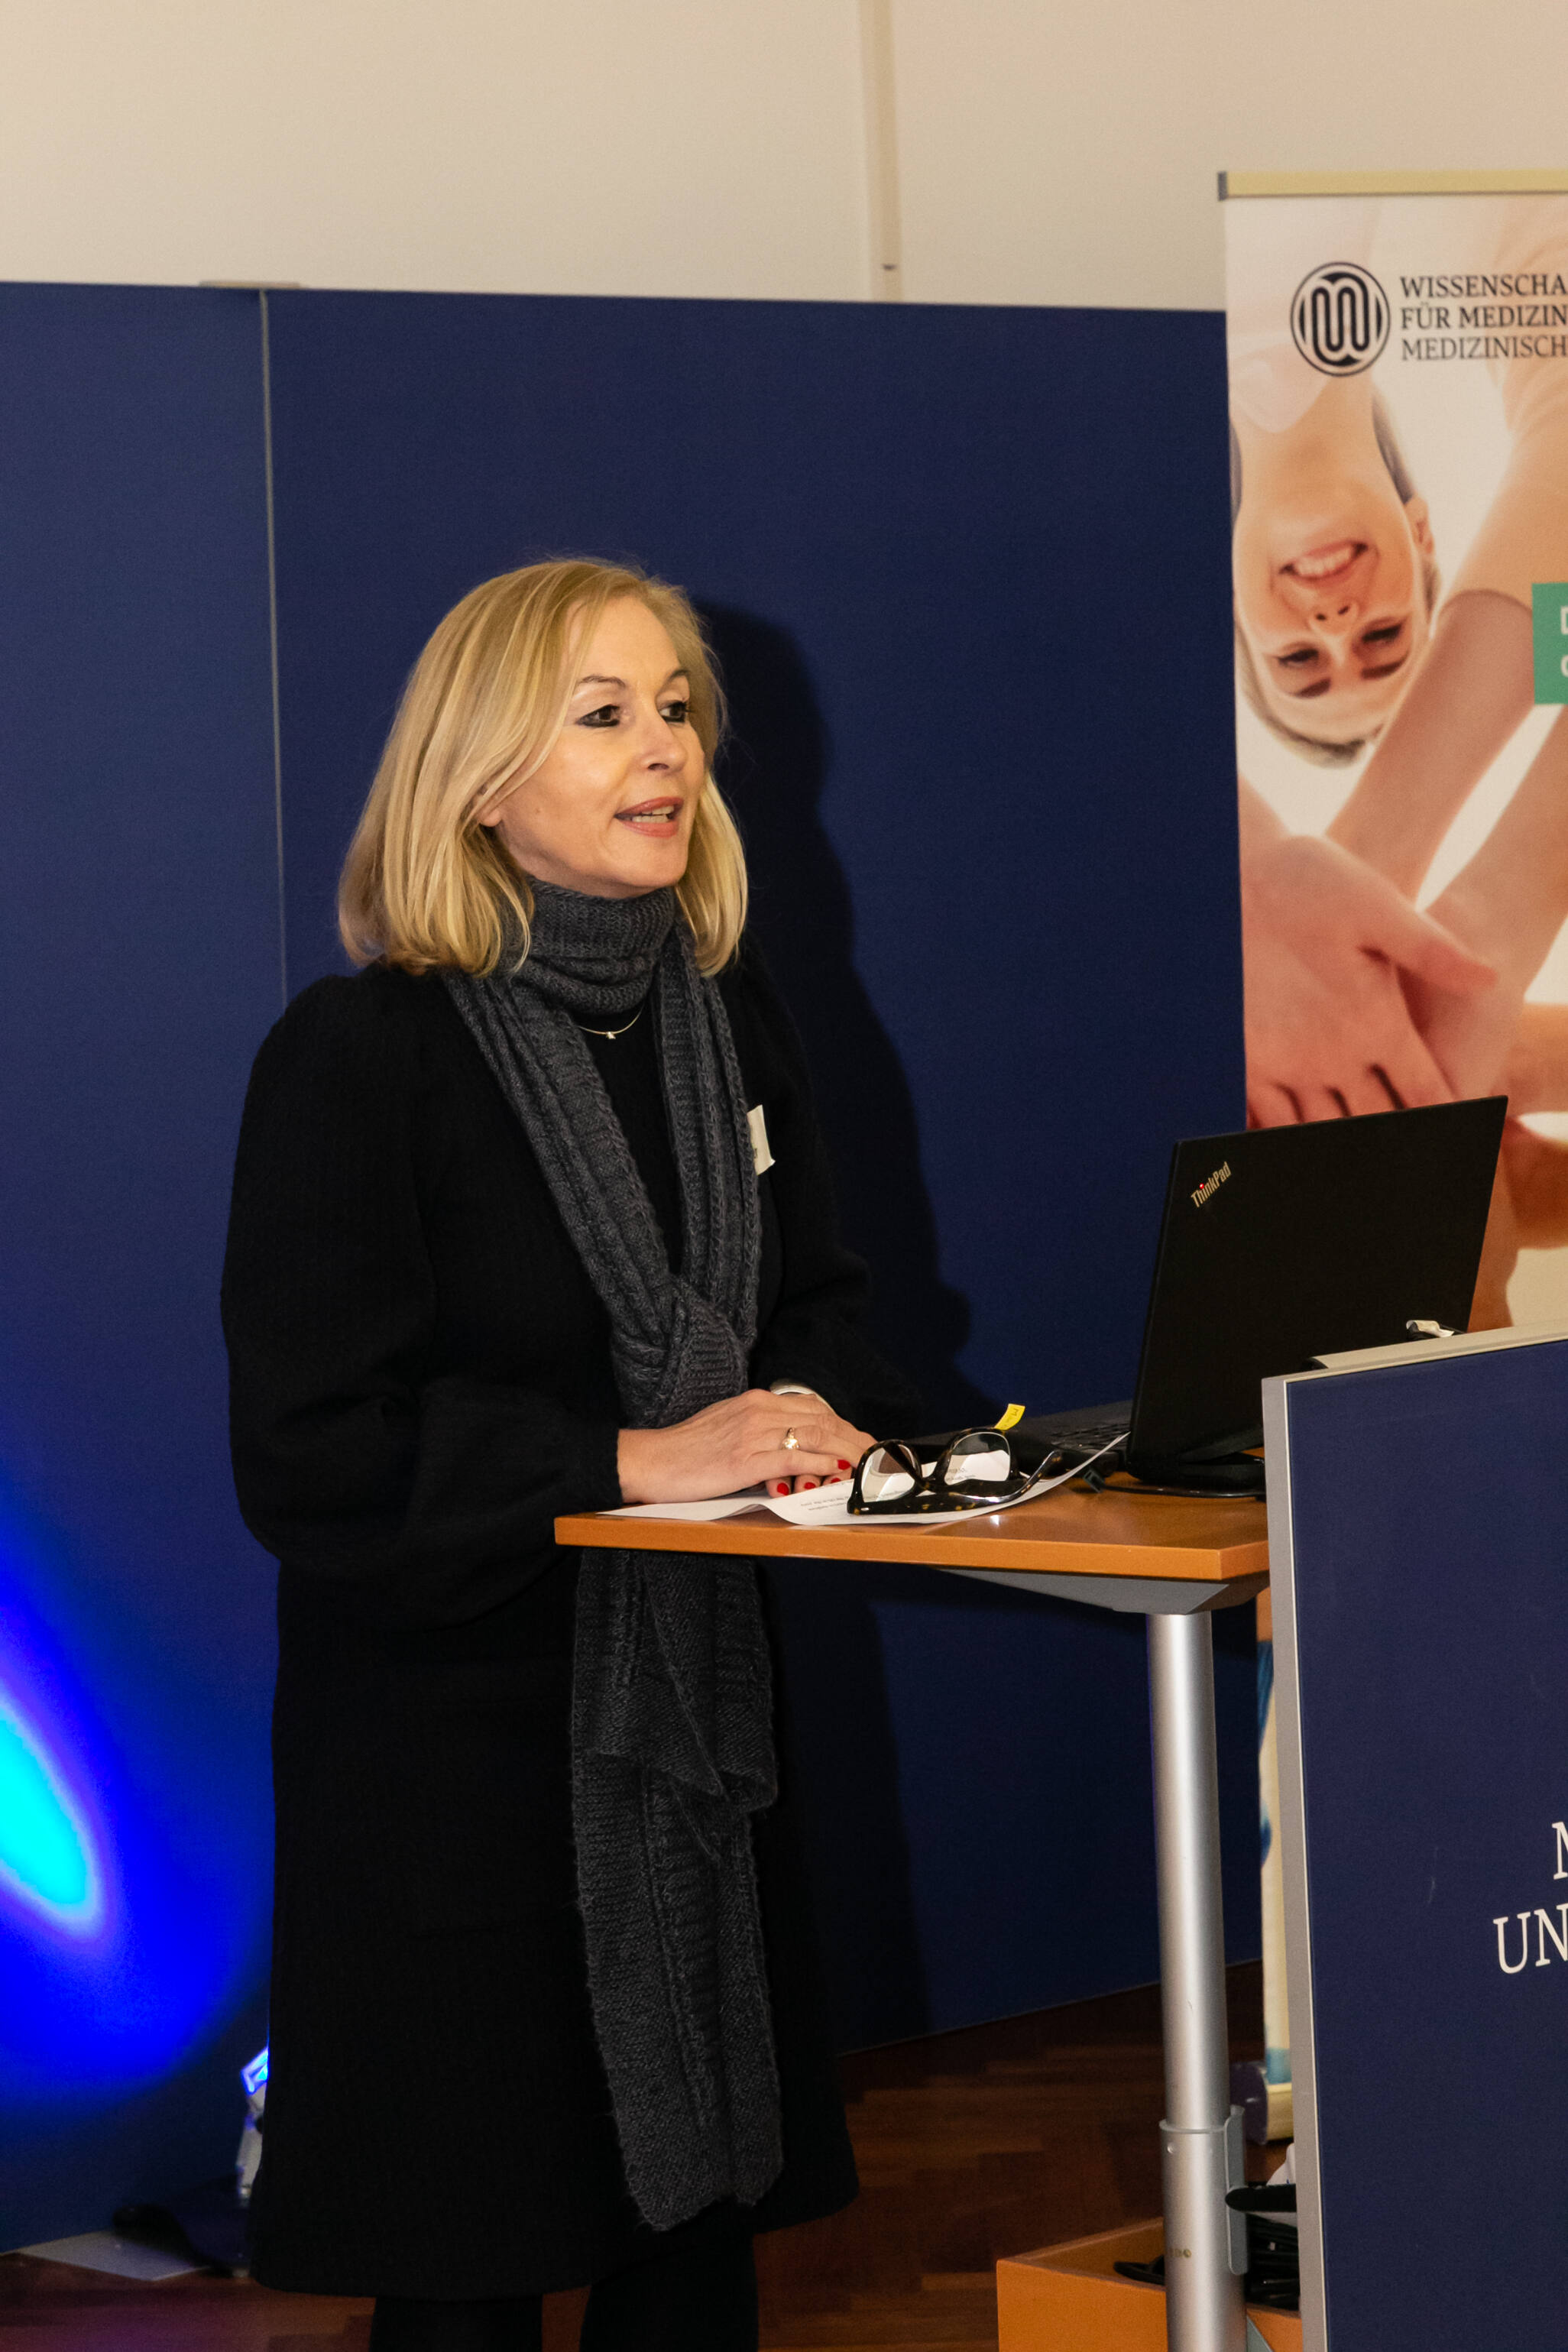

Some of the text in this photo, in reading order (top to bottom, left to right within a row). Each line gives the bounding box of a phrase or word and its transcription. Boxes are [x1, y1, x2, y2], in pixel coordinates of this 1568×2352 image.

[1400, 274, 1568, 297] WISSENSCHA
[1401, 301, 1568, 329] FÜR MEDIZIN
[1401, 335, 1568, 360] MEDIZINISCH
[1191, 1161, 1231, 1207] ThinkPad
[1493, 1903, 1568, 1974] UN
